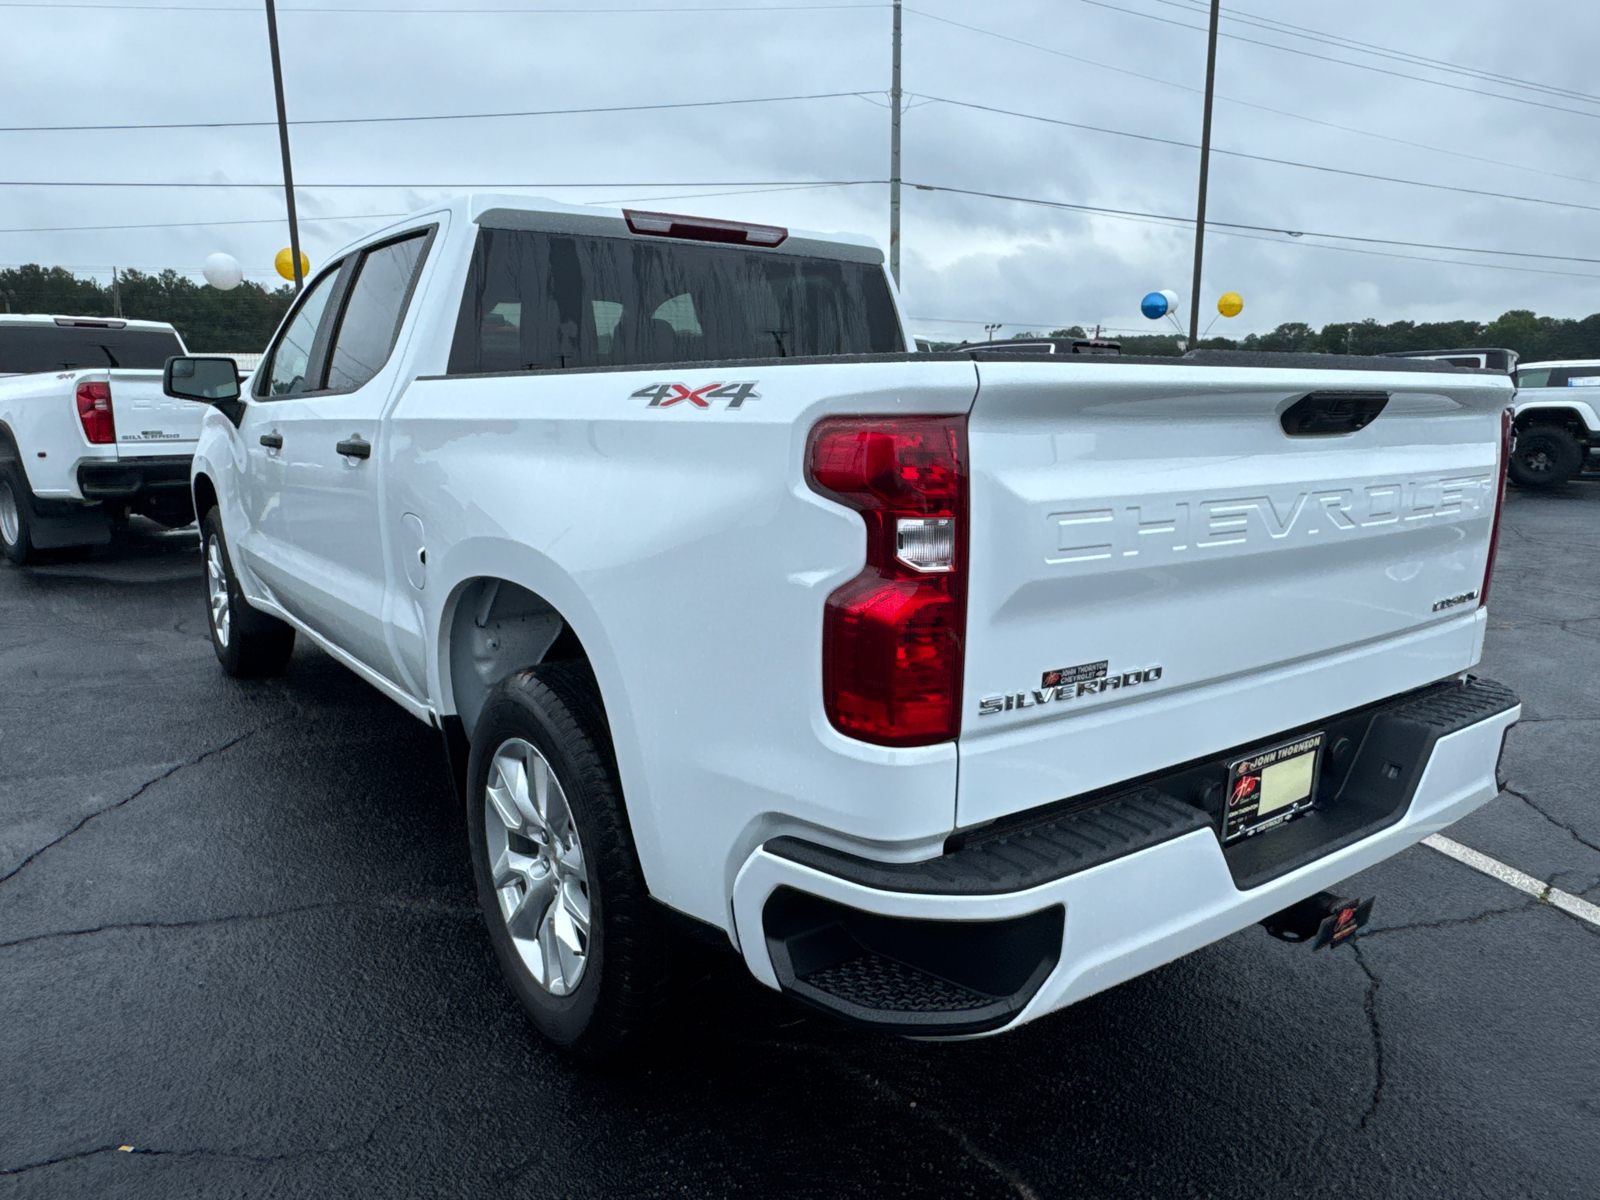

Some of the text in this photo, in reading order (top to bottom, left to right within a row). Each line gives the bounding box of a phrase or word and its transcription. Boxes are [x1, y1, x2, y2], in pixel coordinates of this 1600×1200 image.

[1044, 472, 1492, 565] CHEVROLET
[1060, 671, 1096, 685] CHEVROLET
[1061, 662, 1108, 678] JOHN THORNTON
[979, 664, 1163, 716] SILVERADO
[1251, 736, 1321, 768] JOHN THORNTON
